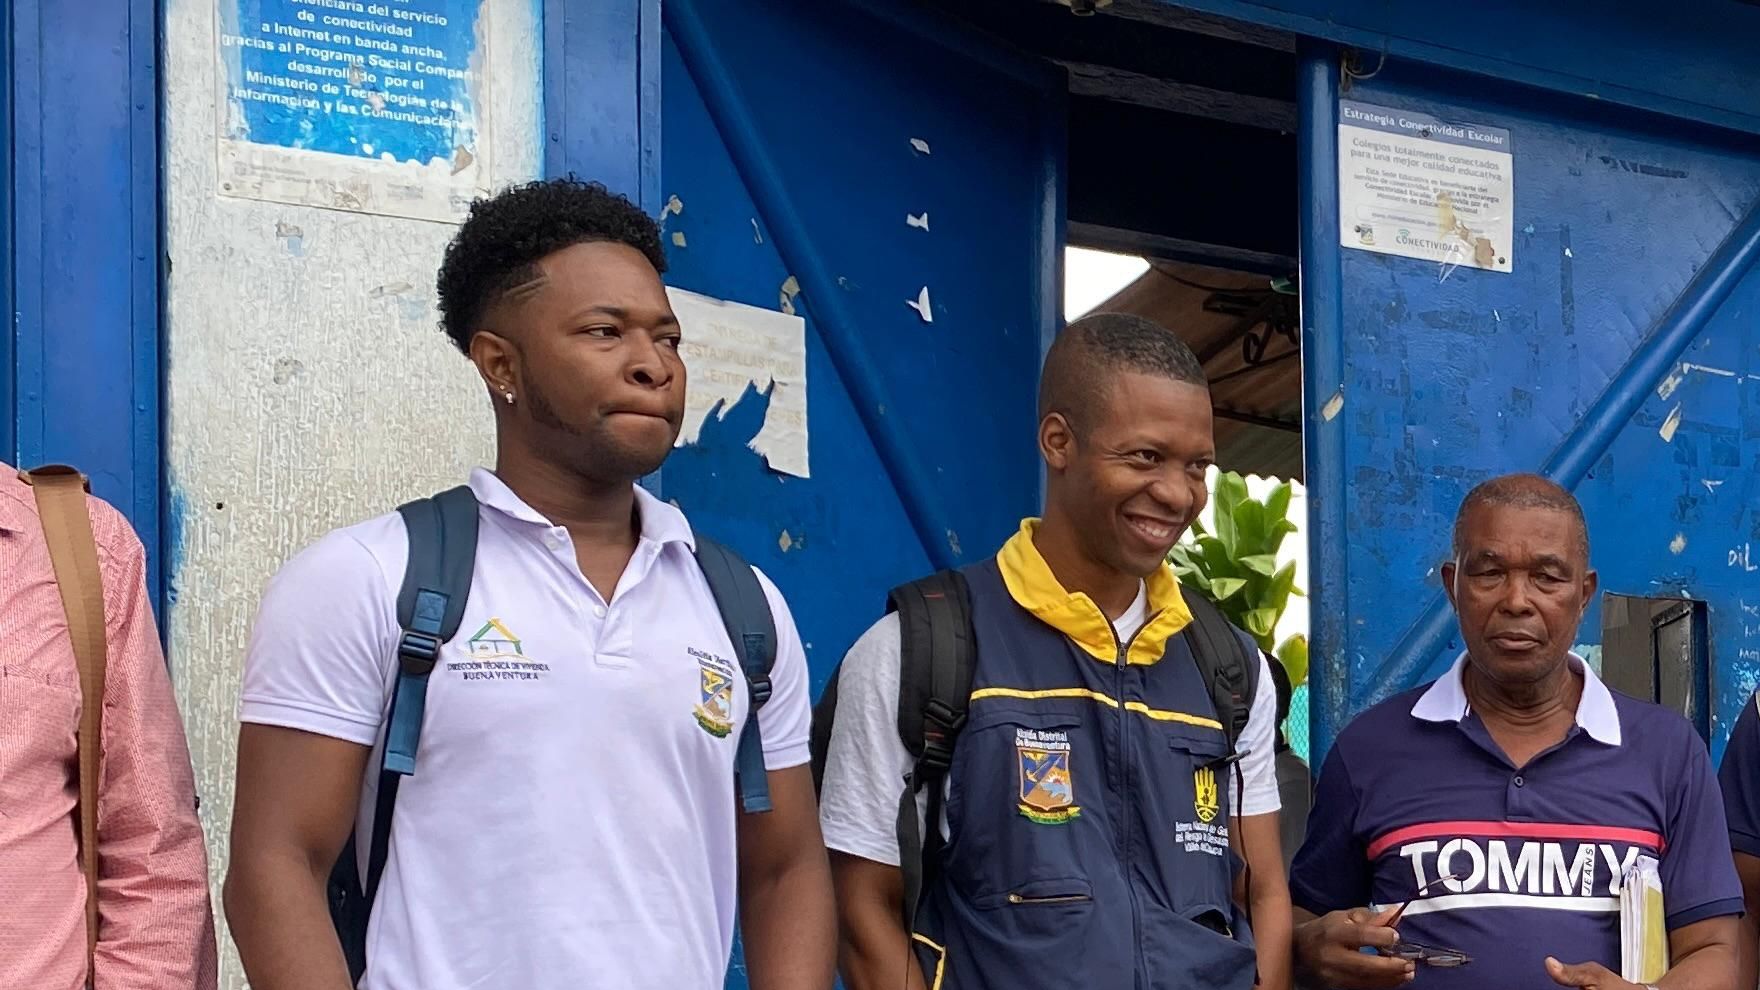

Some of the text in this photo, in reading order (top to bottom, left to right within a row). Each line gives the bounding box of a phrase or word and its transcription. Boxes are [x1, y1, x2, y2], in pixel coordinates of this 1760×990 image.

[297, 9, 413, 37] de conectividad
[368, 3, 388, 17] del
[393, 9, 448, 26] servicio
[261, 23, 270, 32] a
[275, 22, 330, 41] Internet
[333, 34, 351, 45] en
[355, 35, 398, 52] banda
[222, 34, 274, 51] gracias
[278, 41, 291, 53] al
[295, 43, 365, 64] Programa
[368, 54, 411, 72] Social
[246, 71, 318, 92] Ministerio
[322, 83, 340, 94] de
[431, 99, 448, 110] de
[385, 76, 408, 88] por
[412, 79, 424, 90] el
[323, 101, 332, 114] y
[336, 99, 358, 115] las
[1344, 107, 1504, 145] Estrategia Conectividad Escolar
[1350, 149, 1502, 182] para una mejor calidad educativa
[1353, 137, 1499, 171] Colegios totalmente conectados
[1364, 182, 1408, 195] Conectividad
[1451, 204, 1478, 214] Nacional
[1395, 234, 1459, 253] CONECTIVIDAD
[1400, 838, 1639, 897] TOMMY
[1583, 847, 1594, 894] JEANS
